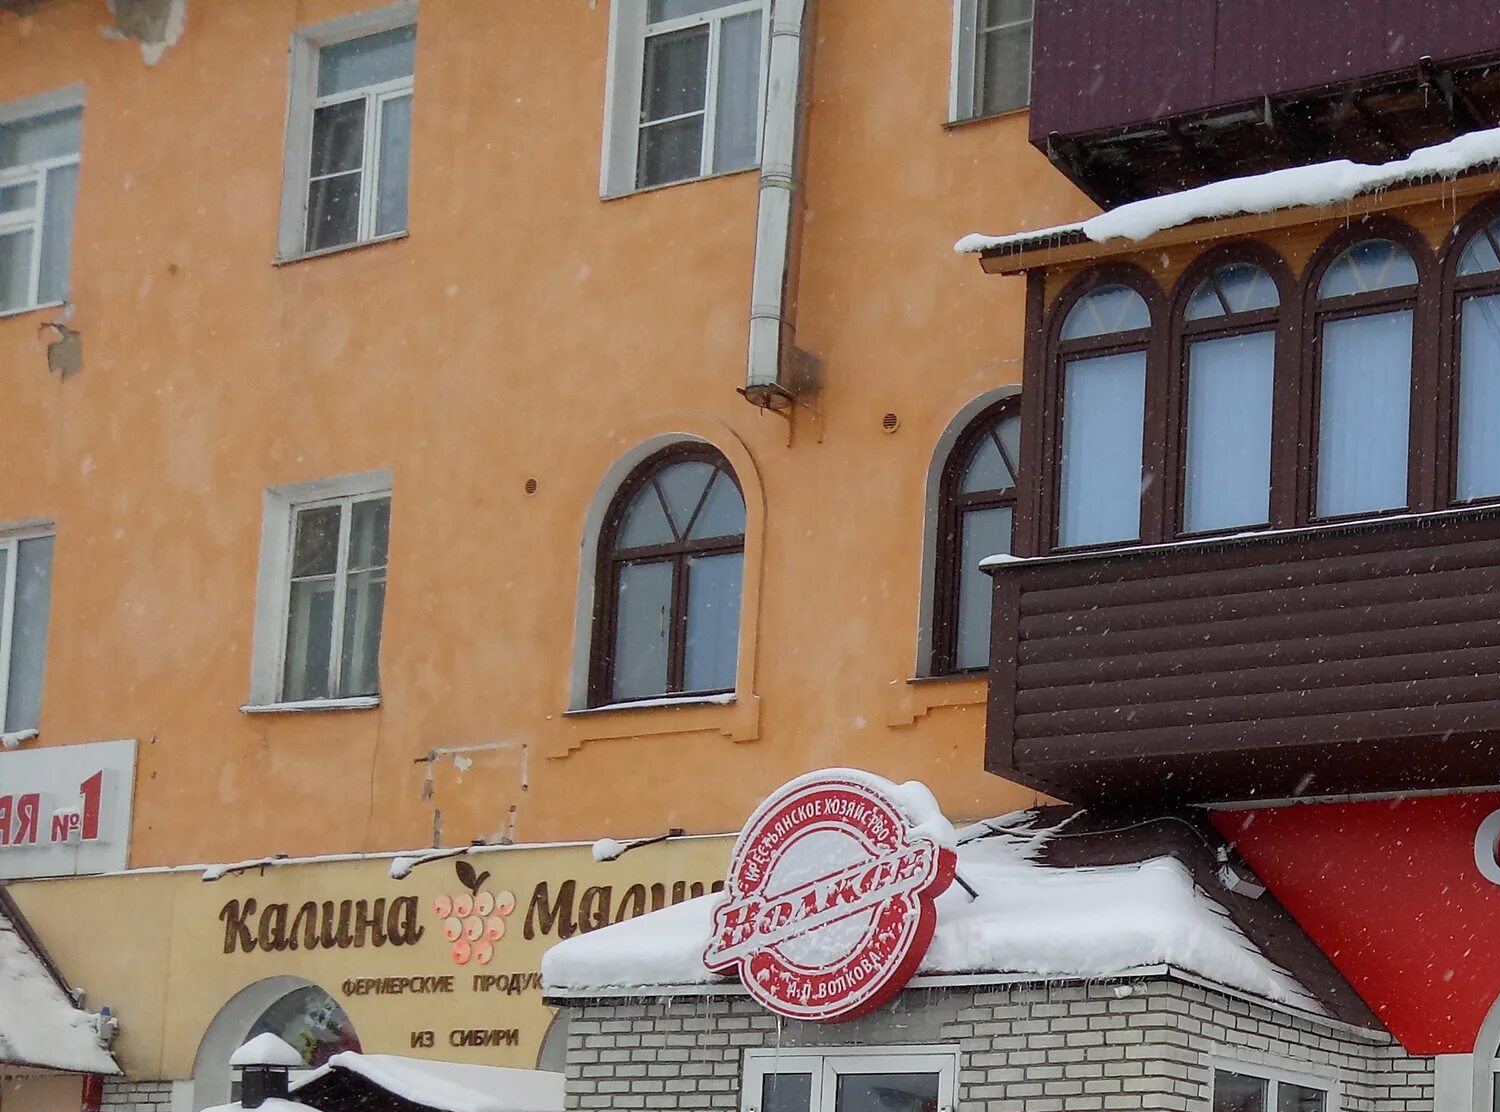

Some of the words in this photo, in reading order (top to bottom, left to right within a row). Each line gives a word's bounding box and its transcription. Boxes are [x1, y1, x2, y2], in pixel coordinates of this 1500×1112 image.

[218, 896, 425, 954] Калина
[341, 974, 455, 997] ФЕРМЕРСКИЕ
[410, 1030, 435, 1048] ИЗ
[449, 1027, 519, 1048] СИБИРИ
